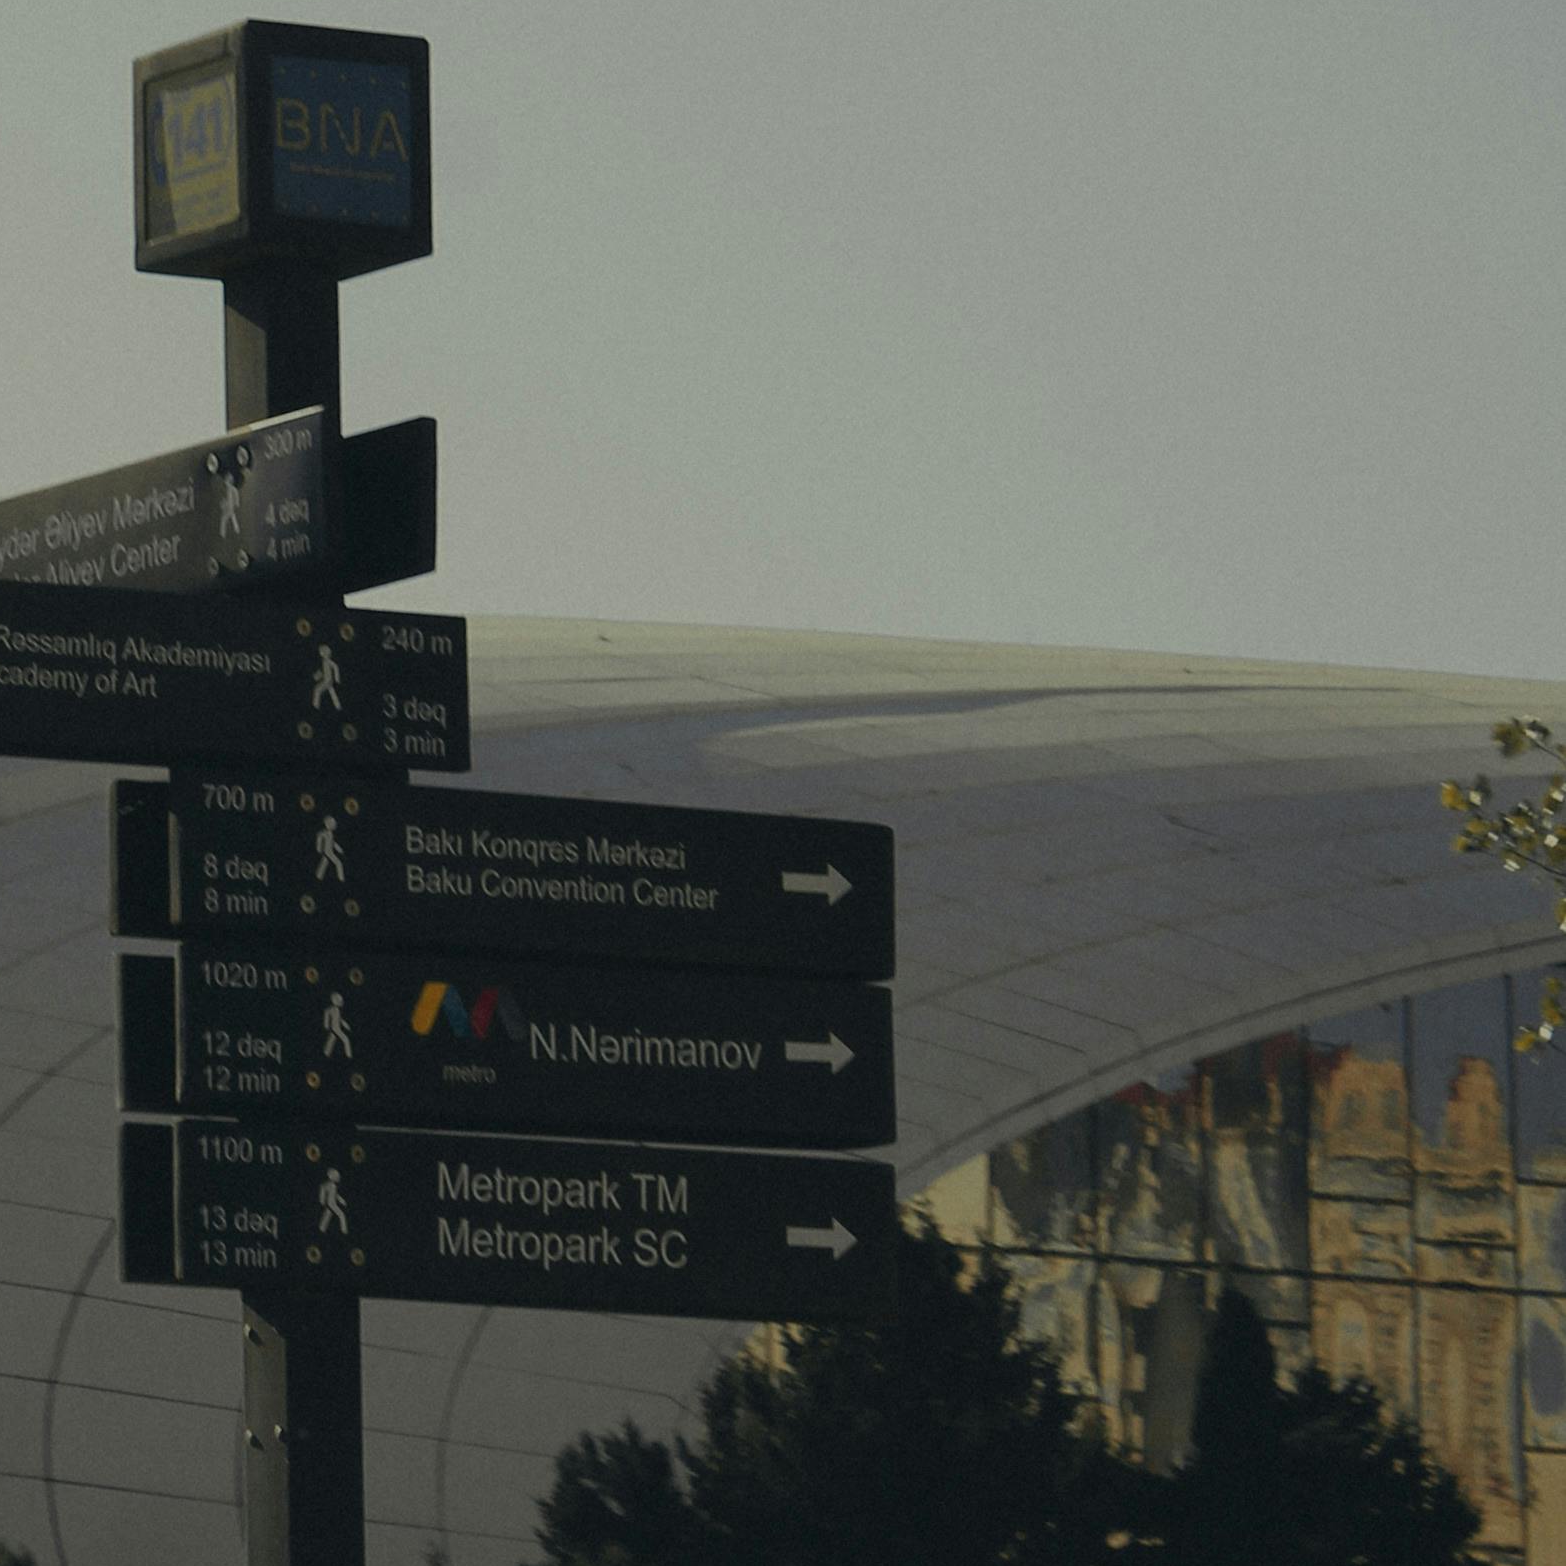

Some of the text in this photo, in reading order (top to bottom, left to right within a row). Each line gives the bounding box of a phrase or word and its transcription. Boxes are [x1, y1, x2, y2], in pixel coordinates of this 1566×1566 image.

[276, 97, 409, 162] BNA
[264, 428, 312, 460] 300 m
[44, 508, 106, 550] Əliyev
[113, 477, 195, 530] Mərkəzi
[265, 502, 275, 526] 4
[110, 534, 181, 577] Center
[267, 530, 310, 561] 4 min
[381, 625, 453, 655] 240 m
[95, 670, 120, 695] of
[122, 674, 157, 699] Art
[382, 693, 447, 726] 3 dəq
[384, 728, 446, 757] 3 min
[203, 784, 275, 814] 700 m
[406, 825, 686, 868] Bakı Konqres Mərkəzi
[204, 853, 269, 886] 8 dəq
[206, 889, 269, 915] 8 min
[407, 864, 719, 911] Baku Convention Center
[202, 962, 288, 990] 1020 m
[204, 1031, 282, 1064] 12 dəq
[531, 1022, 762, 1071] N.Nərimanov
[204, 1066, 280, 1093] 12 min
[443, 1061, 496, 1083] metro
[199, 1137, 283, 1165] 1100 m
[437, 1161, 688, 1215] Metropark TM
[199, 1204, 279, 1238] 13 dəq
[201, 1240, 277, 1269] 13 min
[438, 1217, 688, 1270] Metropark SC
